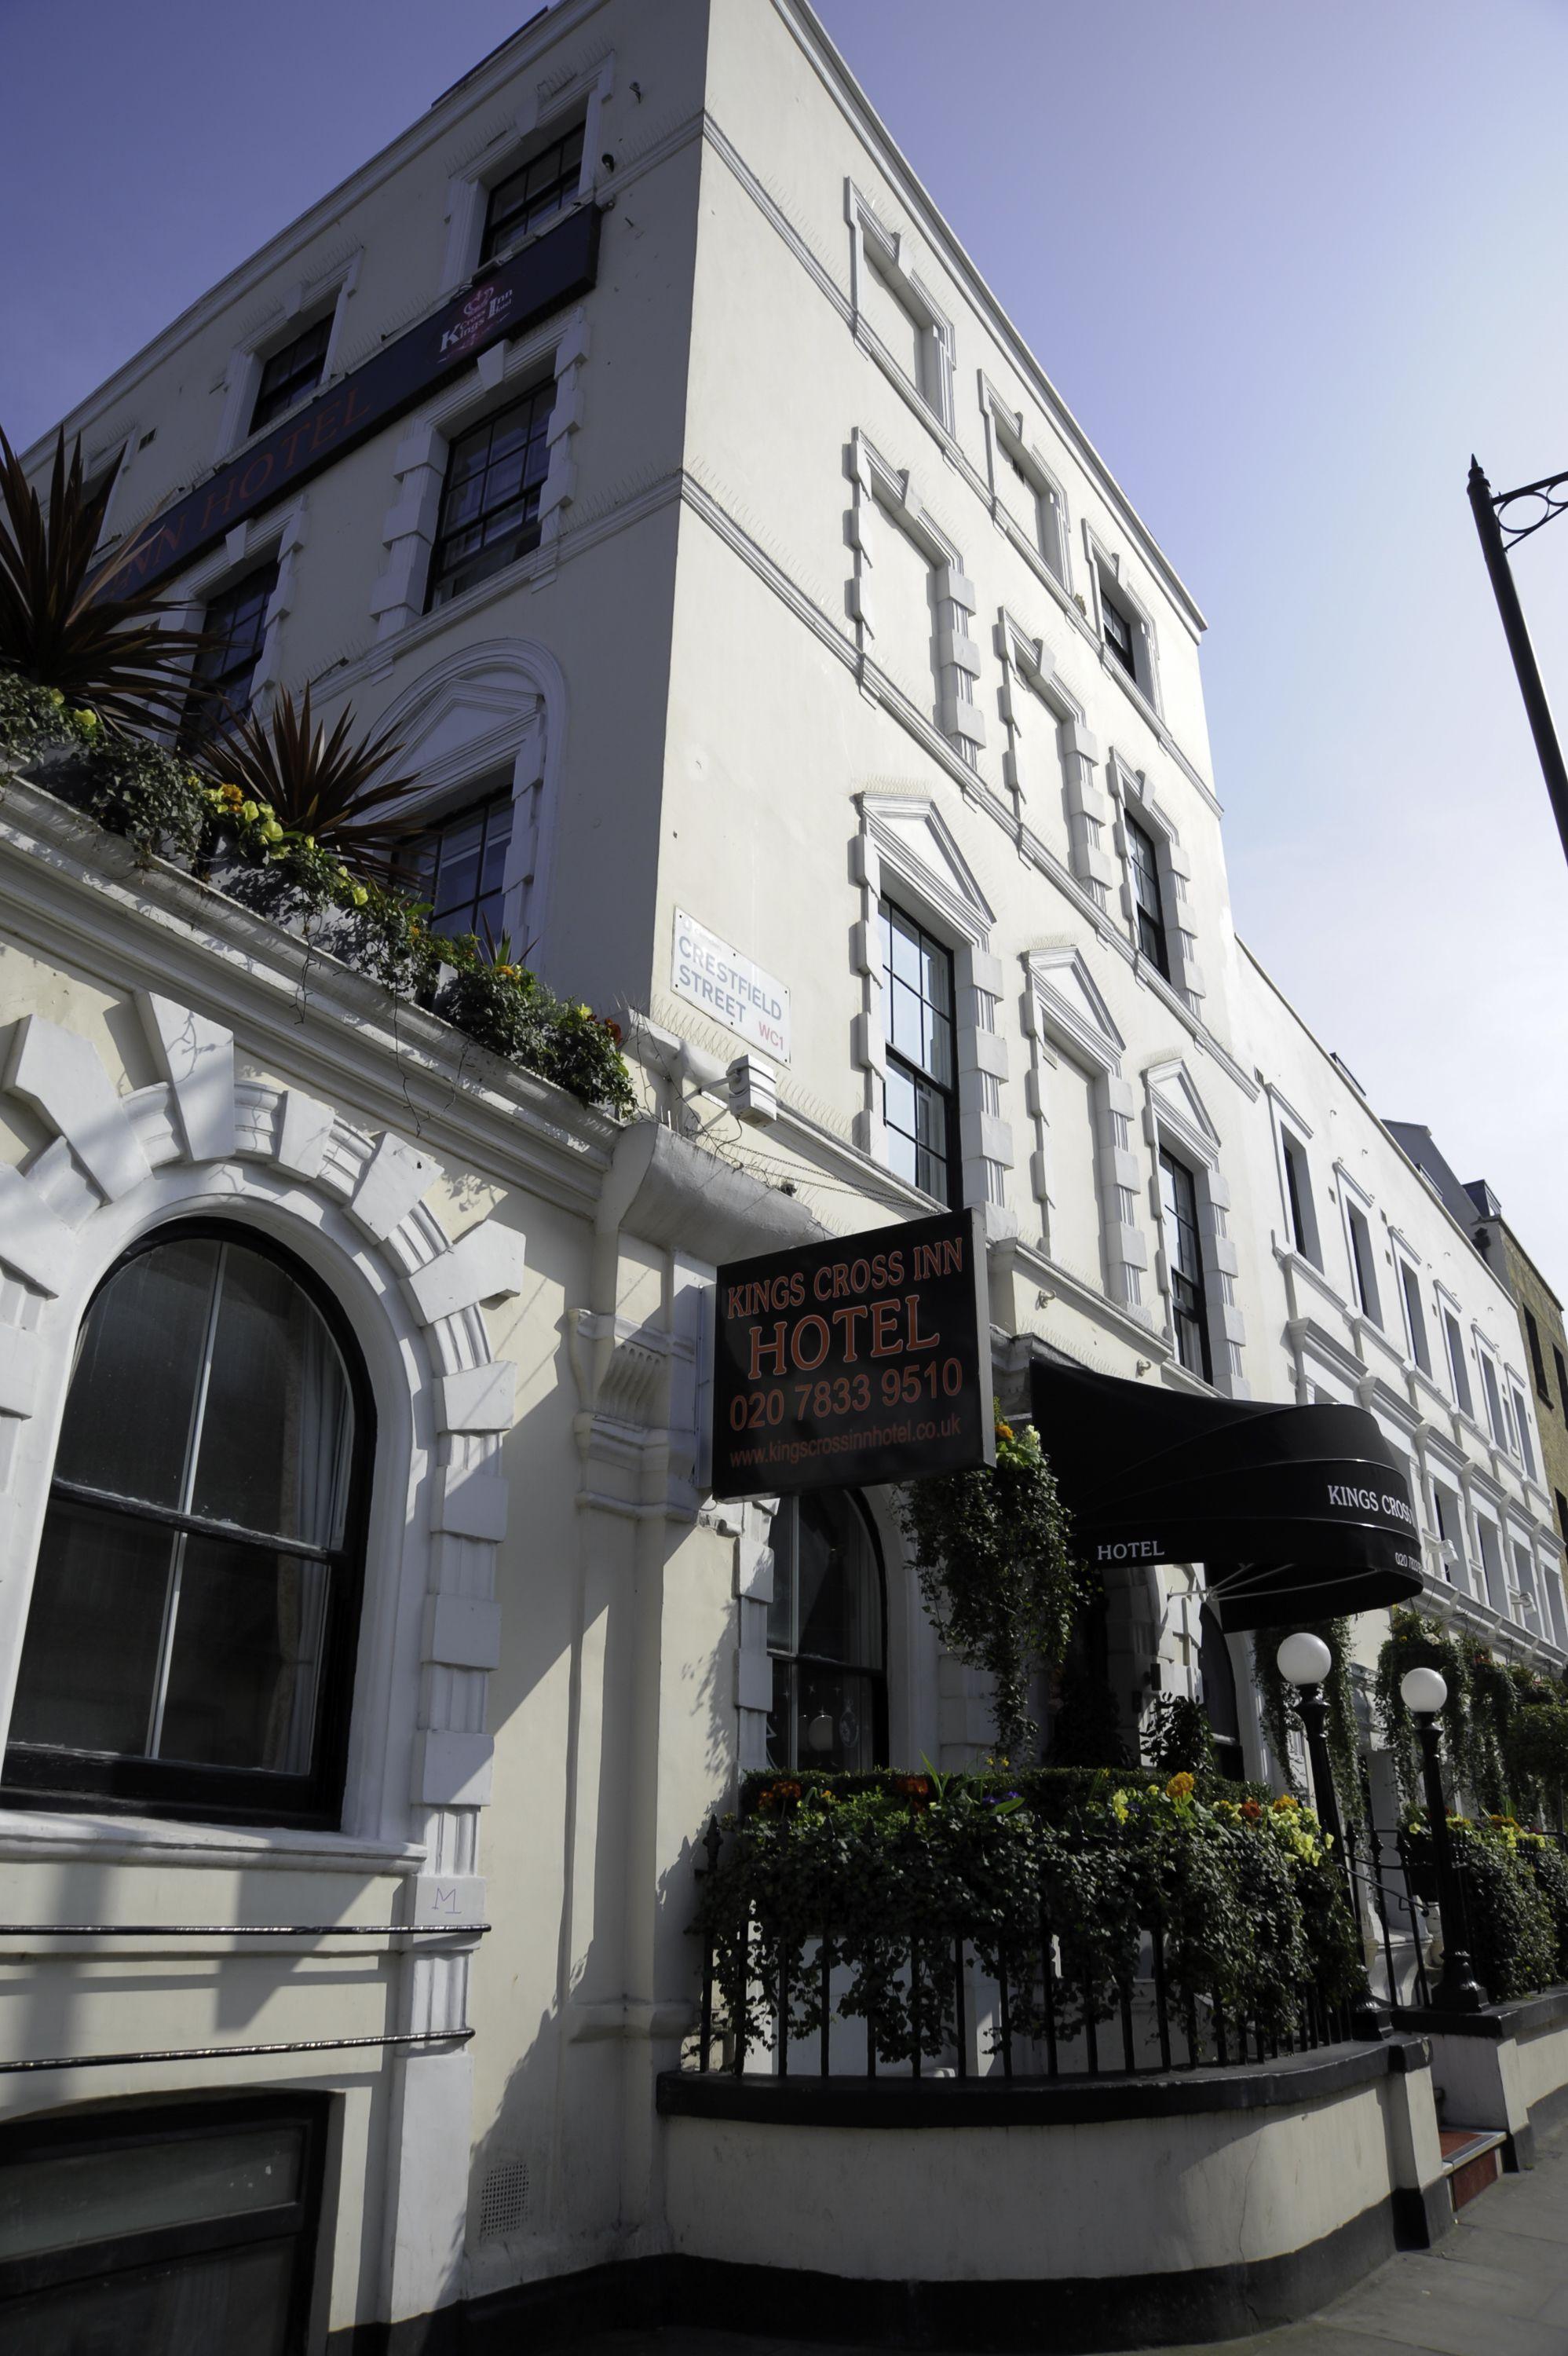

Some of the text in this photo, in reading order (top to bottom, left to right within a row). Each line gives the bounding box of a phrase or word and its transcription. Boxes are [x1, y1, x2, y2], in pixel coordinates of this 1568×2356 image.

[200, 387, 371, 530] HOTEL
[678, 935, 782, 1021] CRESTFIELD
[678, 964, 747, 1023] STREET
[758, 1021, 784, 1051] WC1
[727, 1237, 963, 1319] KINGS CROSS INN
[747, 1294, 941, 1381] HOTEL
[729, 1357, 963, 1432] 020 7833 9510
[729, 1413, 962, 1468] www.kingscrossinnhotel.co.uk
[1327, 1484, 1380, 1513] KINGS
[1097, 1539, 1165, 1560] HOTEL
[1394, 1552, 1408, 1568] 020
